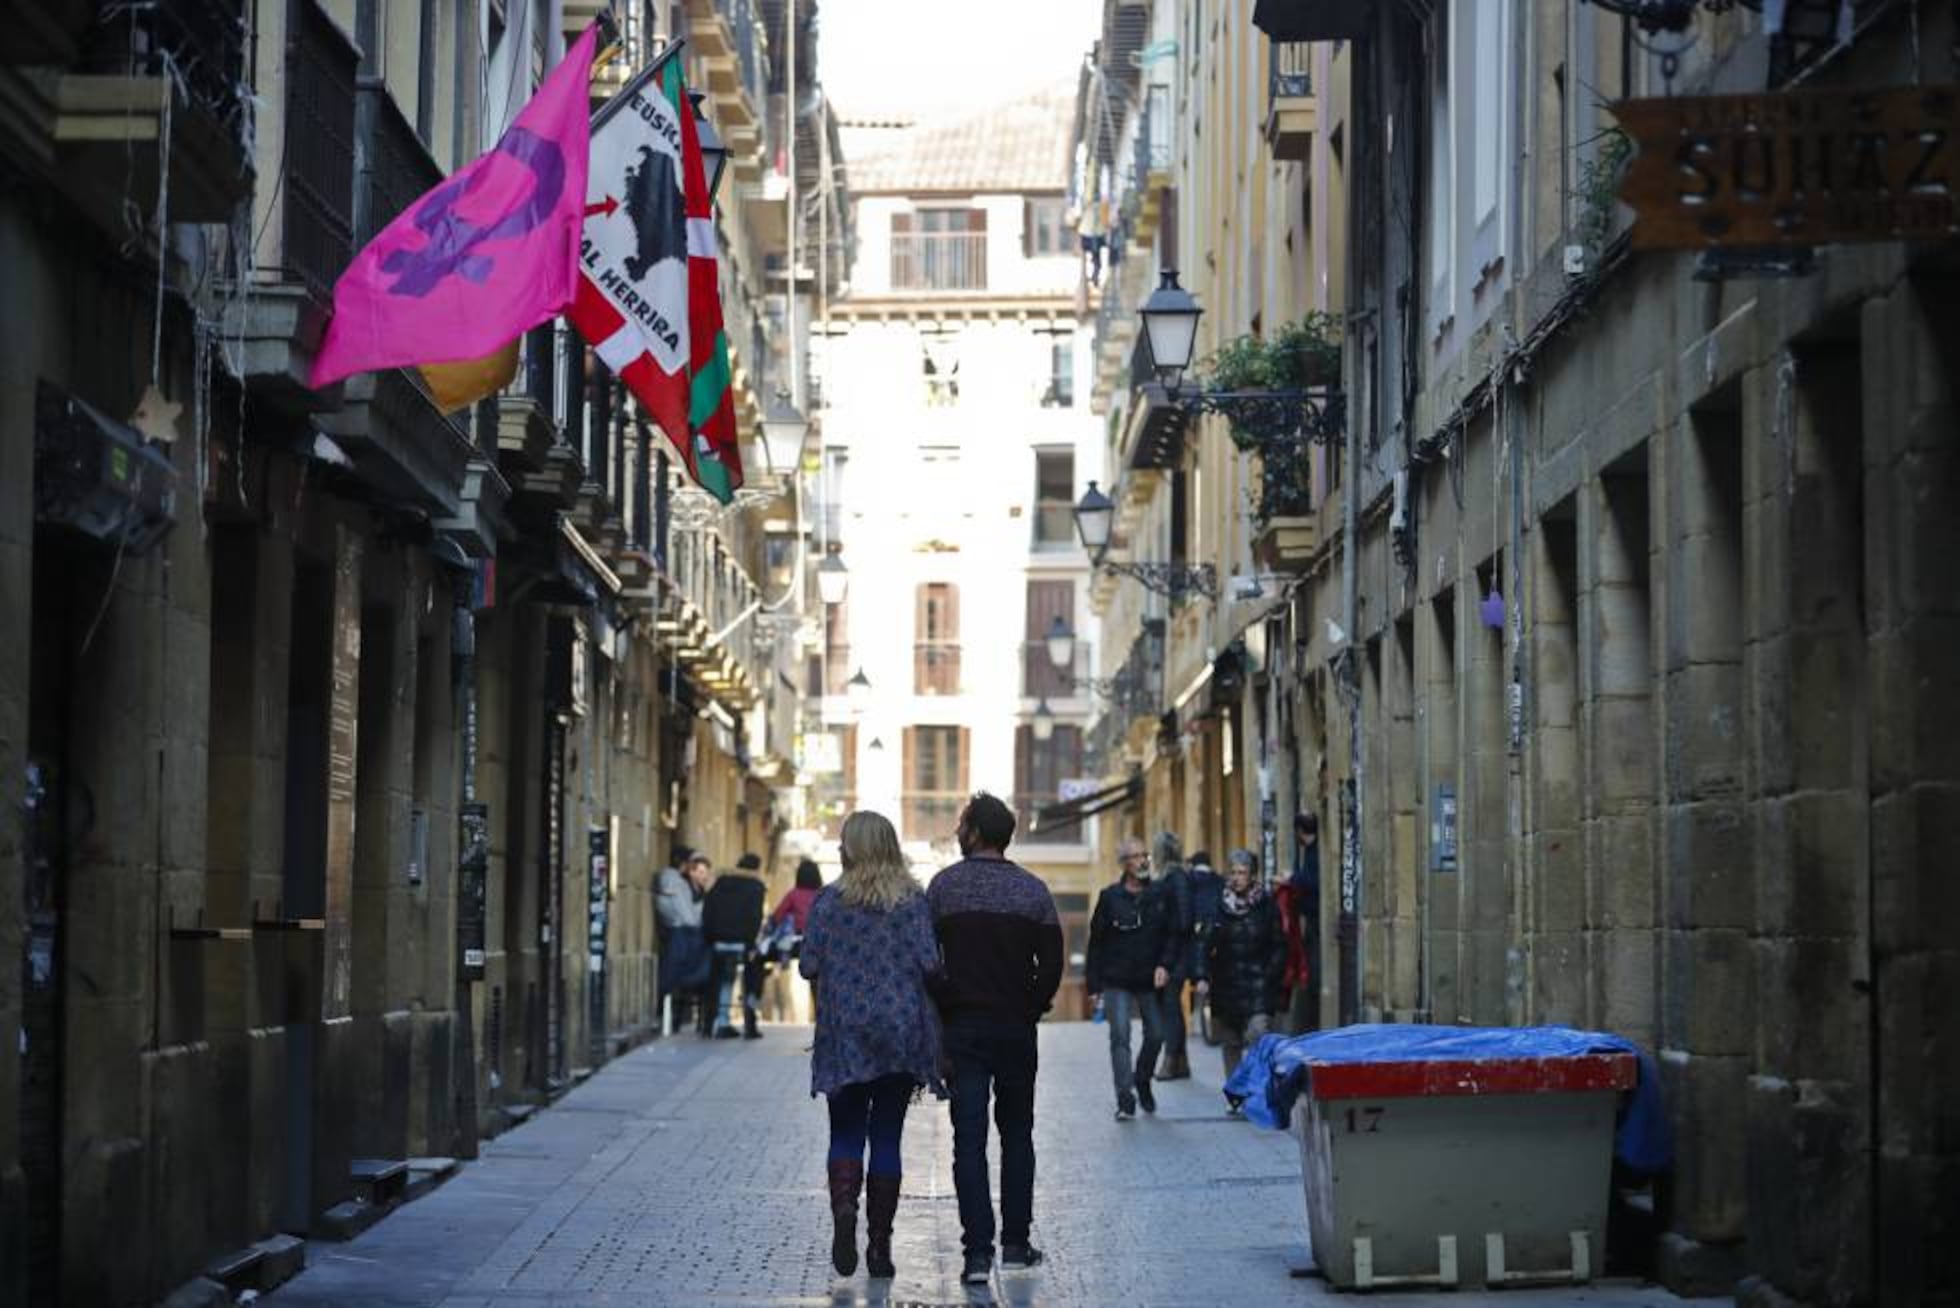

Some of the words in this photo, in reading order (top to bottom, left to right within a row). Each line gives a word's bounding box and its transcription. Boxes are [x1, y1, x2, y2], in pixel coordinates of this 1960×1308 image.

[630, 94, 680, 151] EUSK
[600, 267, 679, 352] HERRIRA
[1343, 1107, 1384, 1134] 17
